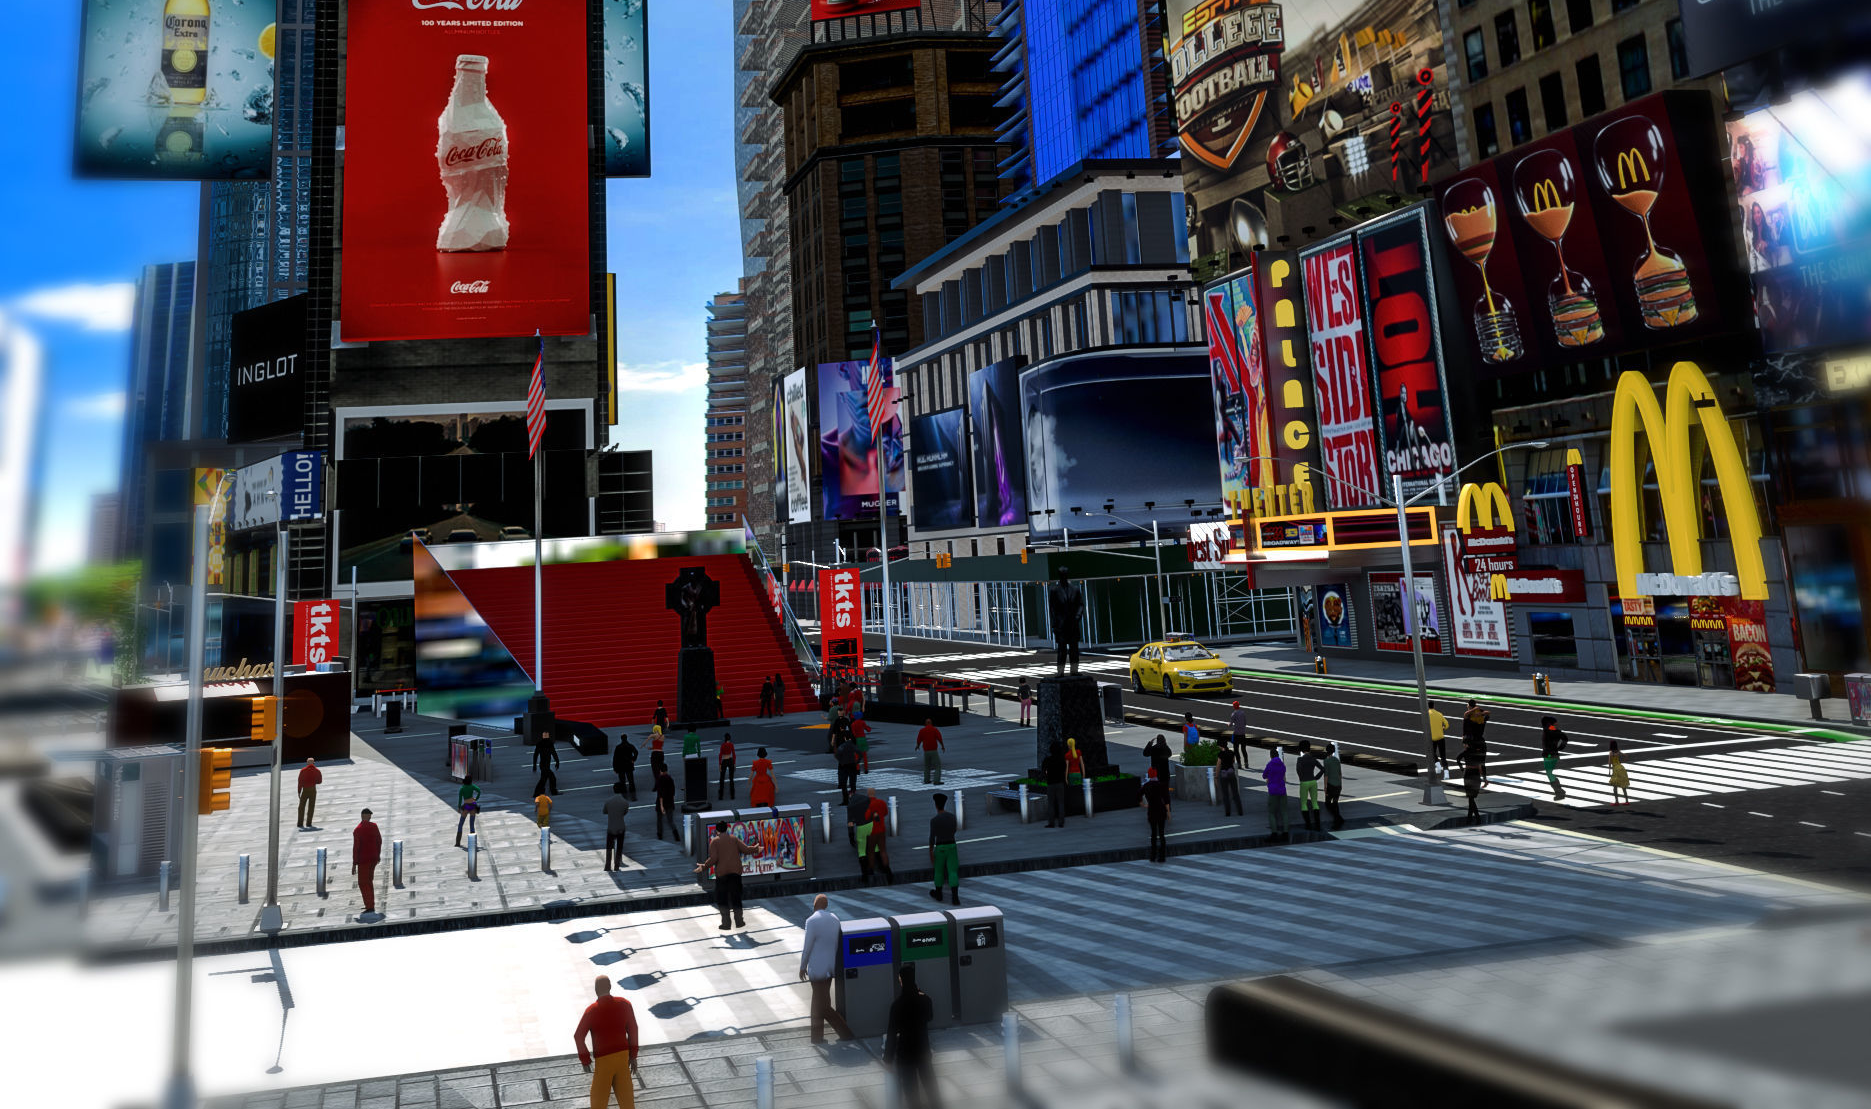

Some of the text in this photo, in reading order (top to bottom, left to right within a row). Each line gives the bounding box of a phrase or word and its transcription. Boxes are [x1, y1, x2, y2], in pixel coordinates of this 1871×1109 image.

[165, 15, 208, 30] Corona
[174, 28, 198, 37] Extra
[1175, 54, 1275, 121] OOTBALL
[237, 353, 298, 386] INGLOT
[1386, 441, 1452, 474] CHICAGO
[294, 453, 314, 518] HELLO!
[1228, 482, 1316, 520] THEATER
[1569, 466, 1577, 493] OPEN
[1574, 500, 1583, 535] HOURS
[861, 499, 897, 508] MUGER
[1474, 557, 1514, 572] 24 hours
[834, 571, 855, 628] tkts
[309, 603, 332, 664] tkts
[1732, 623, 1767, 643] BACON
[203, 657, 274, 681] uchas
